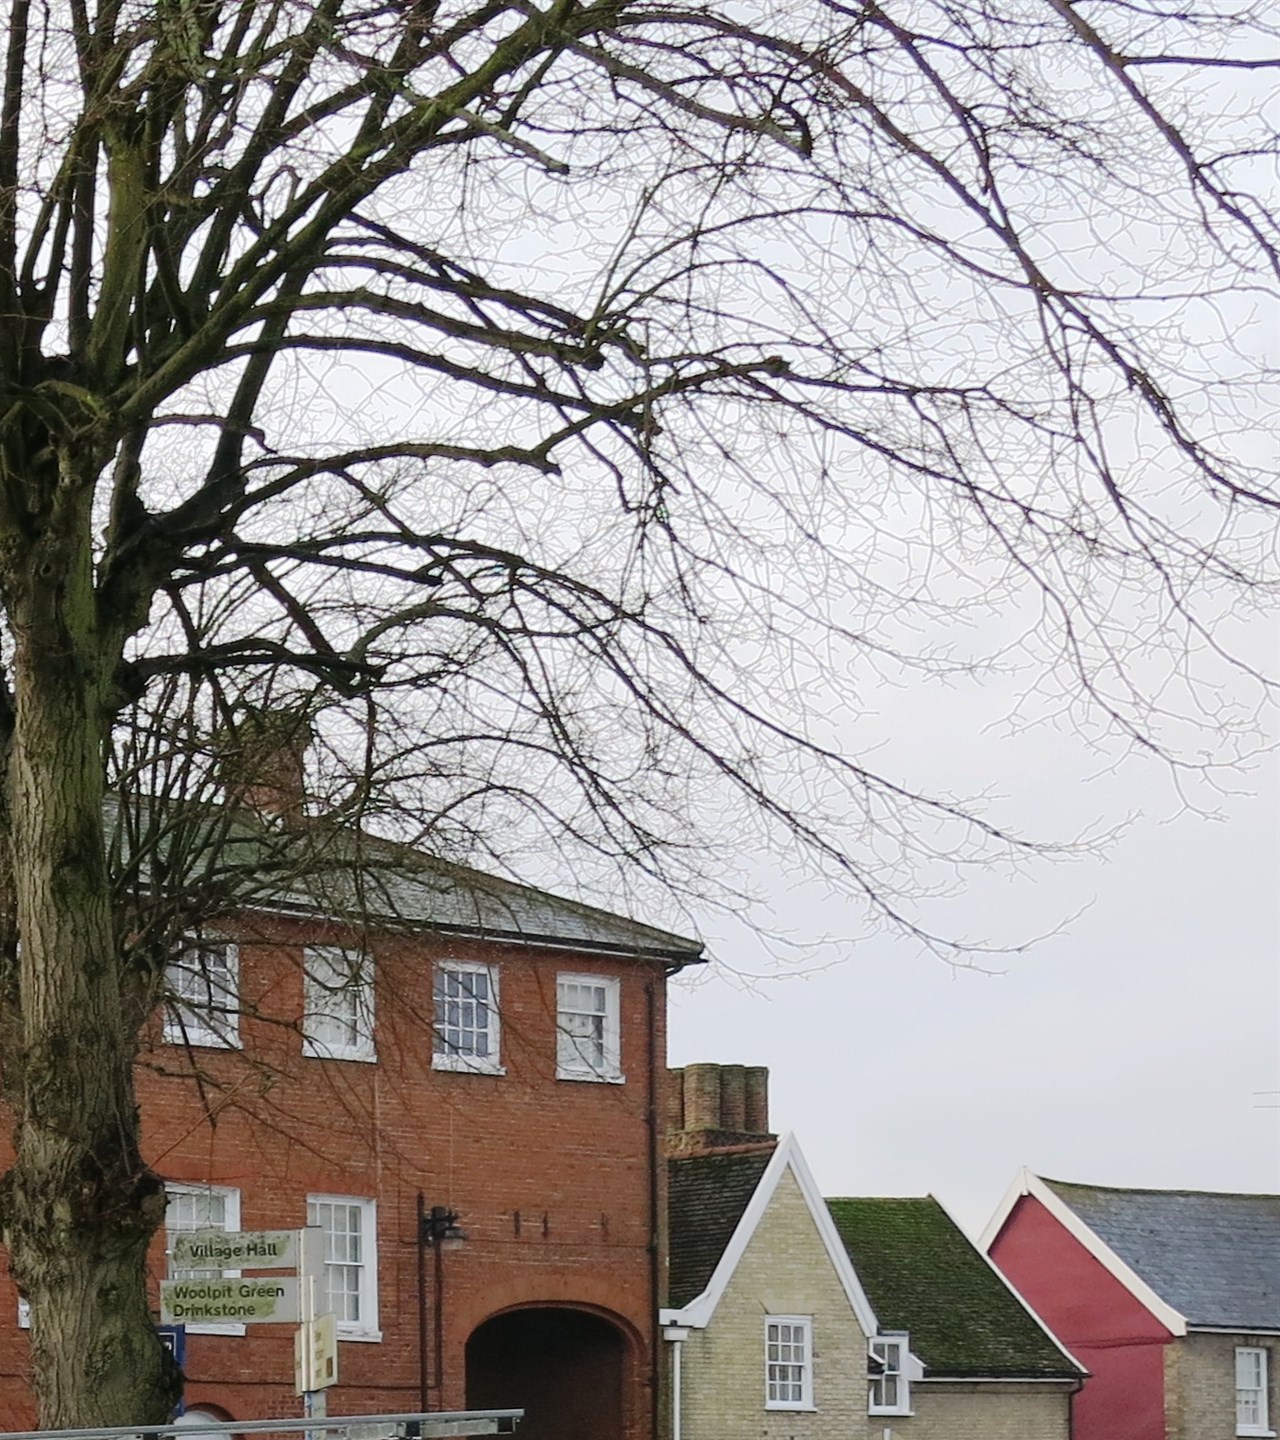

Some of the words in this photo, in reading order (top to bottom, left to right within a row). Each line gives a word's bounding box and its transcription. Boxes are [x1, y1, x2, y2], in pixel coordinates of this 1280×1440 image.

[189, 1244, 241, 1259] Village
[246, 1243, 278, 1257] Hall
[175, 1285, 232, 1301] Woolpit
[239, 1284, 285, 1298] Green
[174, 1303, 256, 1317] Drinkstone
